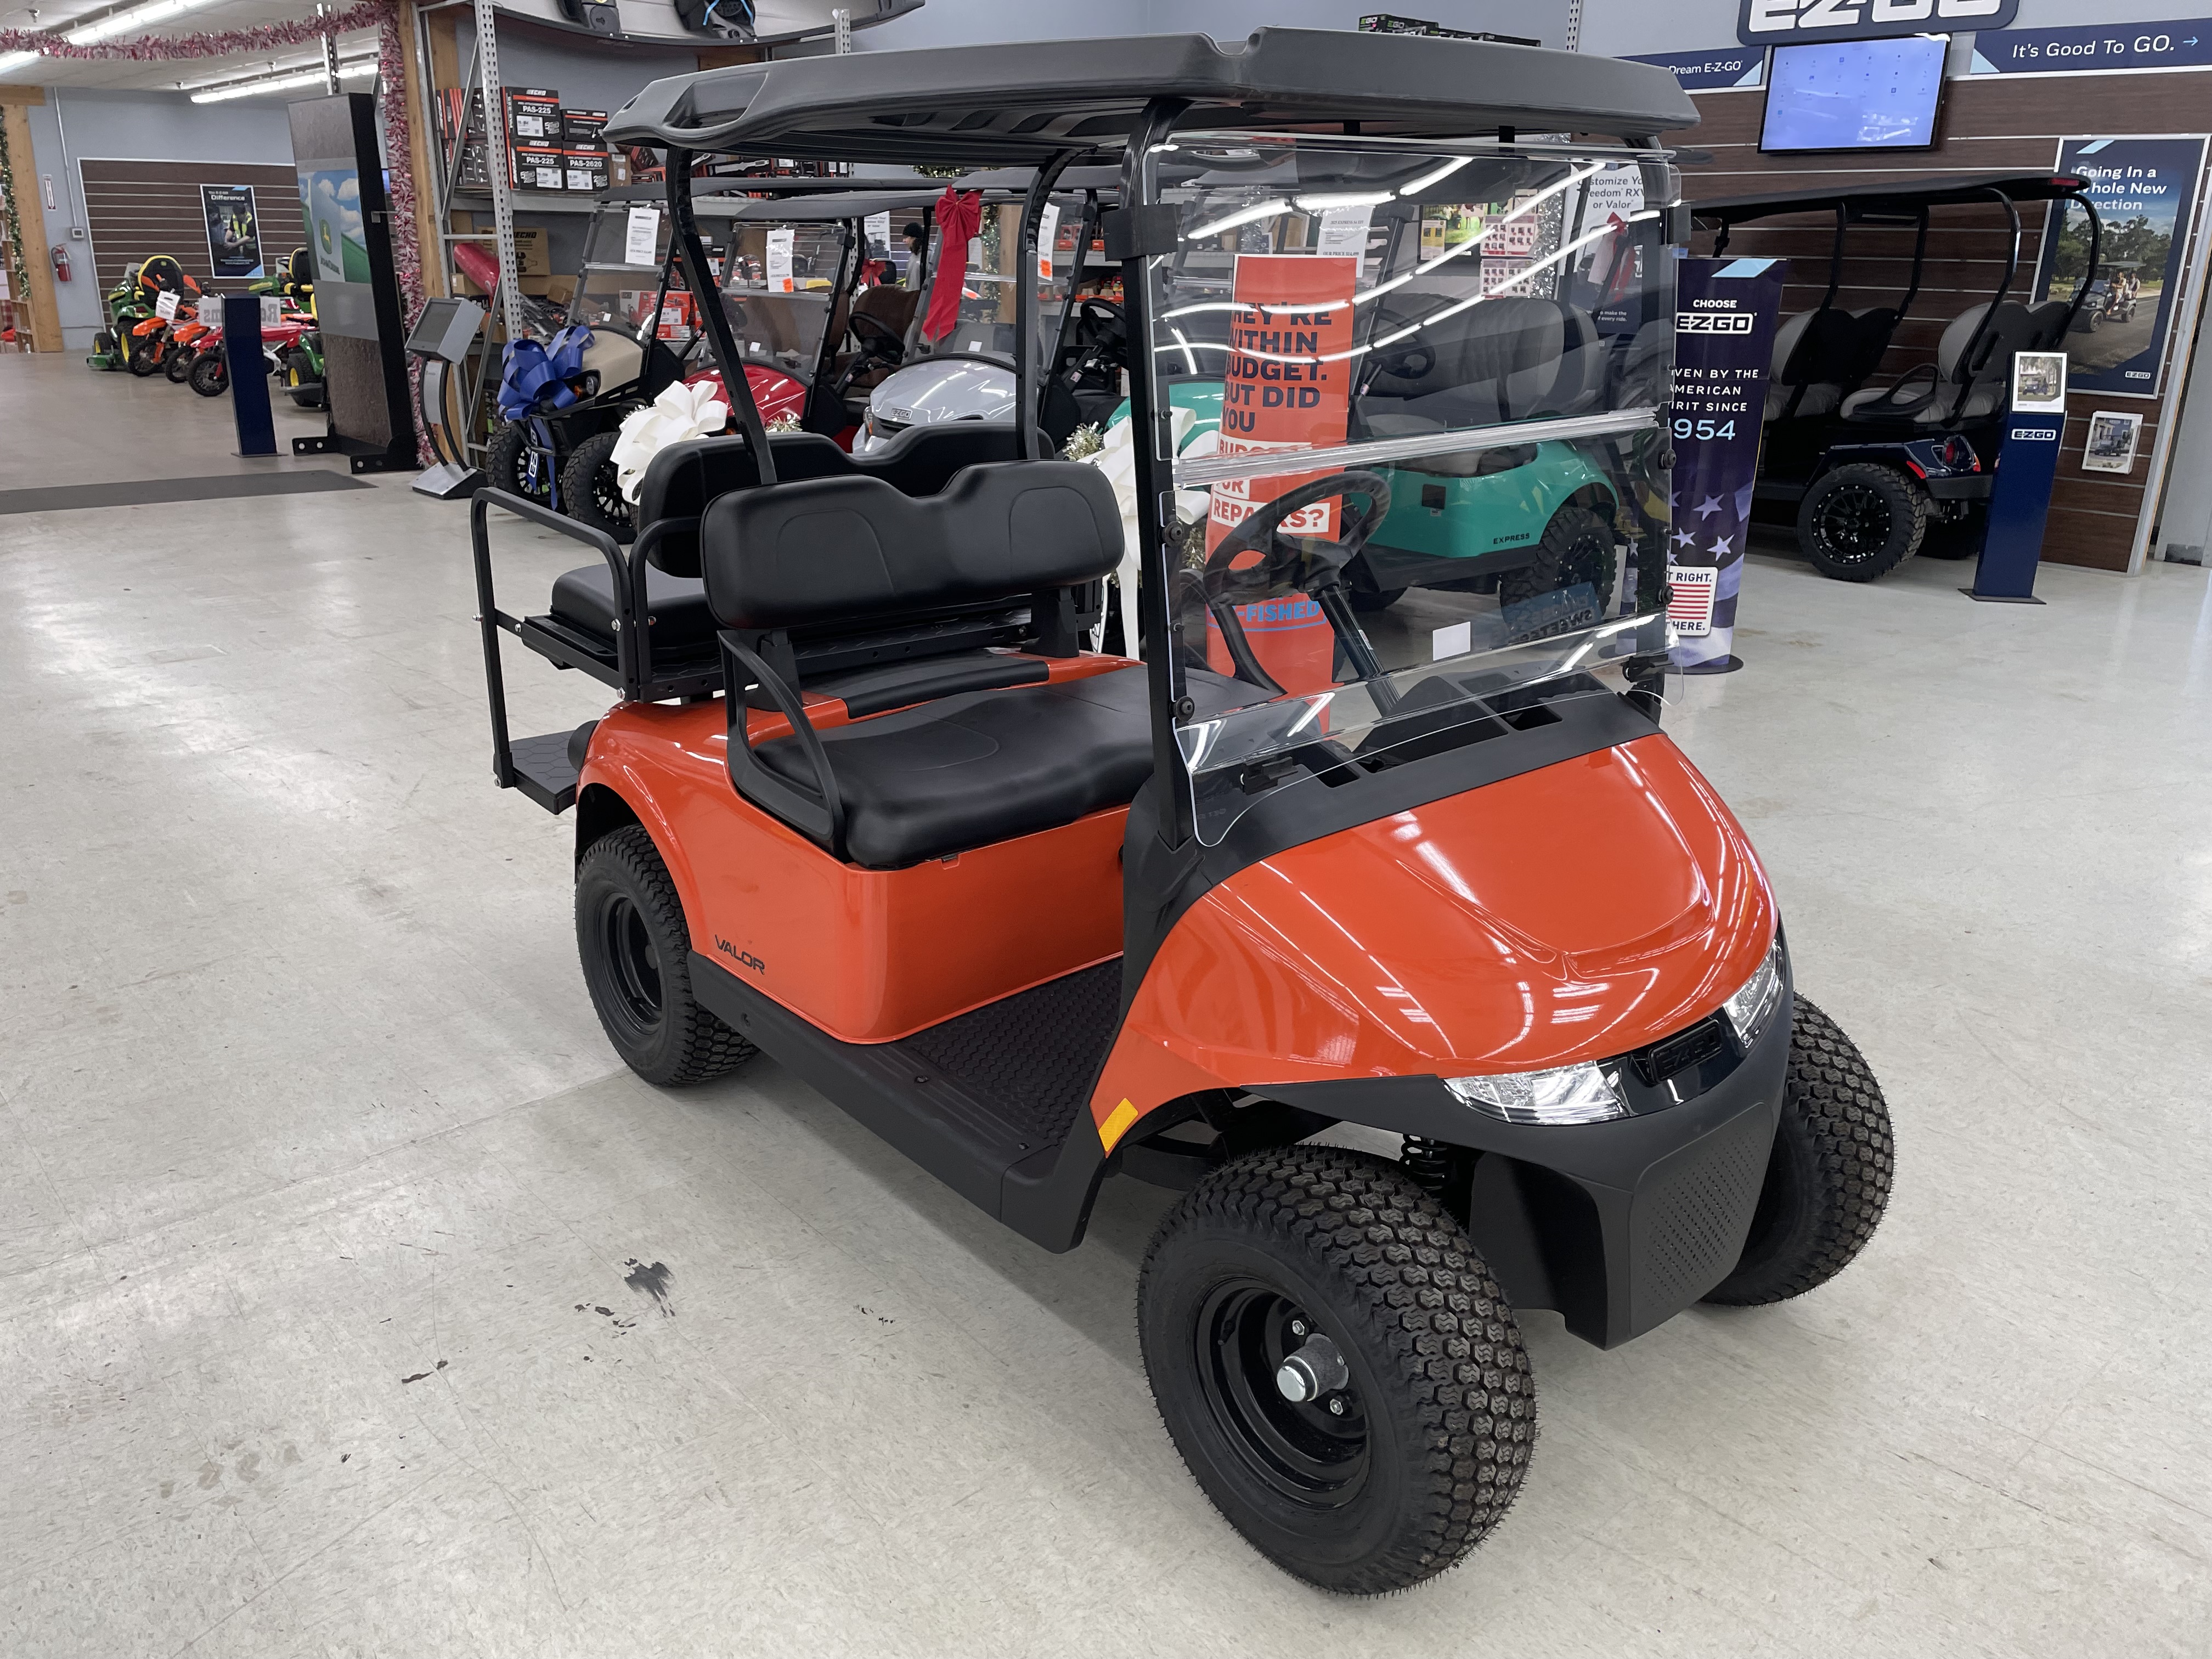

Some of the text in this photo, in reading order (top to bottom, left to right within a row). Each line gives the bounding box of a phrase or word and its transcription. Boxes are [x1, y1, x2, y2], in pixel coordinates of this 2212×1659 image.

[2012, 35, 2174, 58] It's Good To GO.
[1669, 60, 1741, 75] Dream E-Z-GO
[522, 105, 551, 114] PAS-225
[526, 156, 554, 165] PAS-225
[2076, 166, 2157, 180] Going In a
[1589, 189, 1621, 197] eedom
[2076, 182, 2167, 194] hole New
[1606, 200, 1632, 208] Valor
[2070, 199, 2142, 210] Dection
[1693, 300, 1737, 308] CHOOSE
[1676, 314, 1751, 332] EZGO
[1671, 369, 1759, 379] IVEN BY THE
[1262, 386, 1320, 408] DID
[1668, 401, 1747, 411] IRIT SINCE
[891, 408, 911, 418] EZGO
[2012, 430, 2055, 440] EZGO
[1213, 498, 1324, 528] REPAS?
[1493, 532, 1530, 544] EXPRESS
[1676, 572, 1712, 582] RIGHT.
[1673, 621, 1705, 630] HERE.
[715, 934, 765, 975] VALOR
